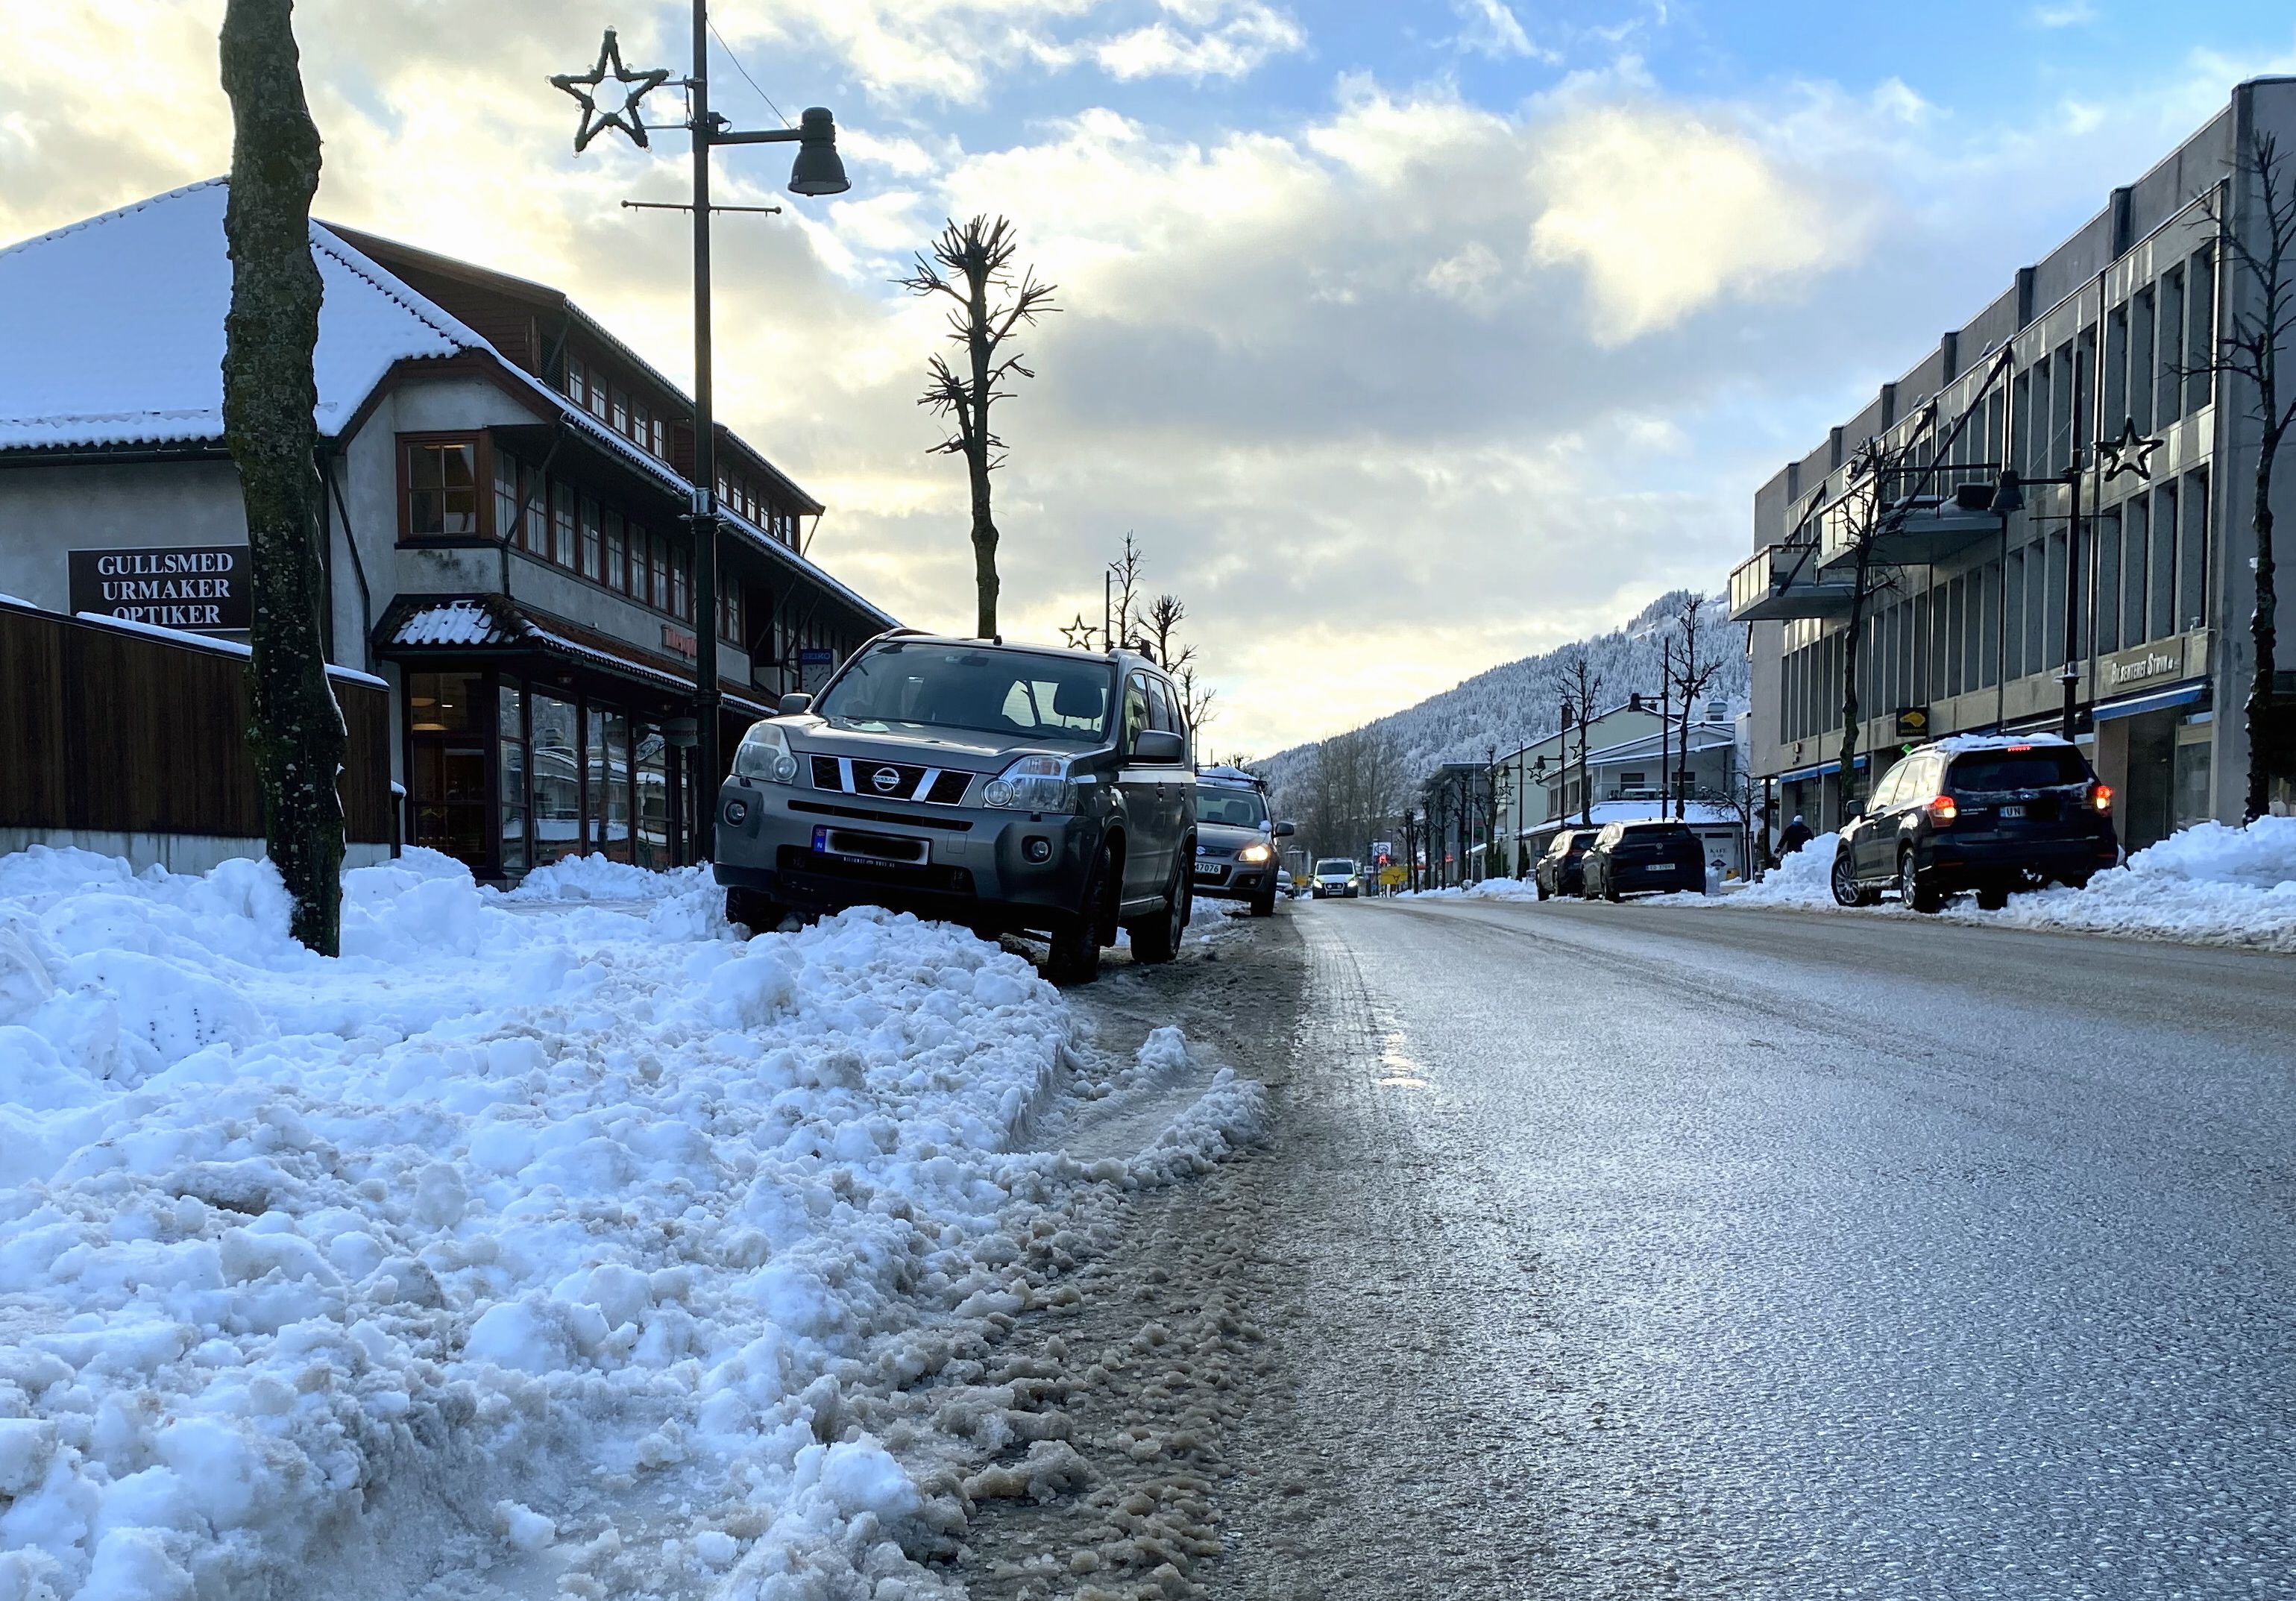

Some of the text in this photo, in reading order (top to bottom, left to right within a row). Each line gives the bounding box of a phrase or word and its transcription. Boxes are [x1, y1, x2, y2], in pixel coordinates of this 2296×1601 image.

[97, 553, 233, 576] GULLSMED
[101, 579, 230, 601] URMAKER
[113, 605, 221, 625] OPTIKER
[802, 652, 831, 660] SEIKO
[2007, 808, 2020, 816] UN
